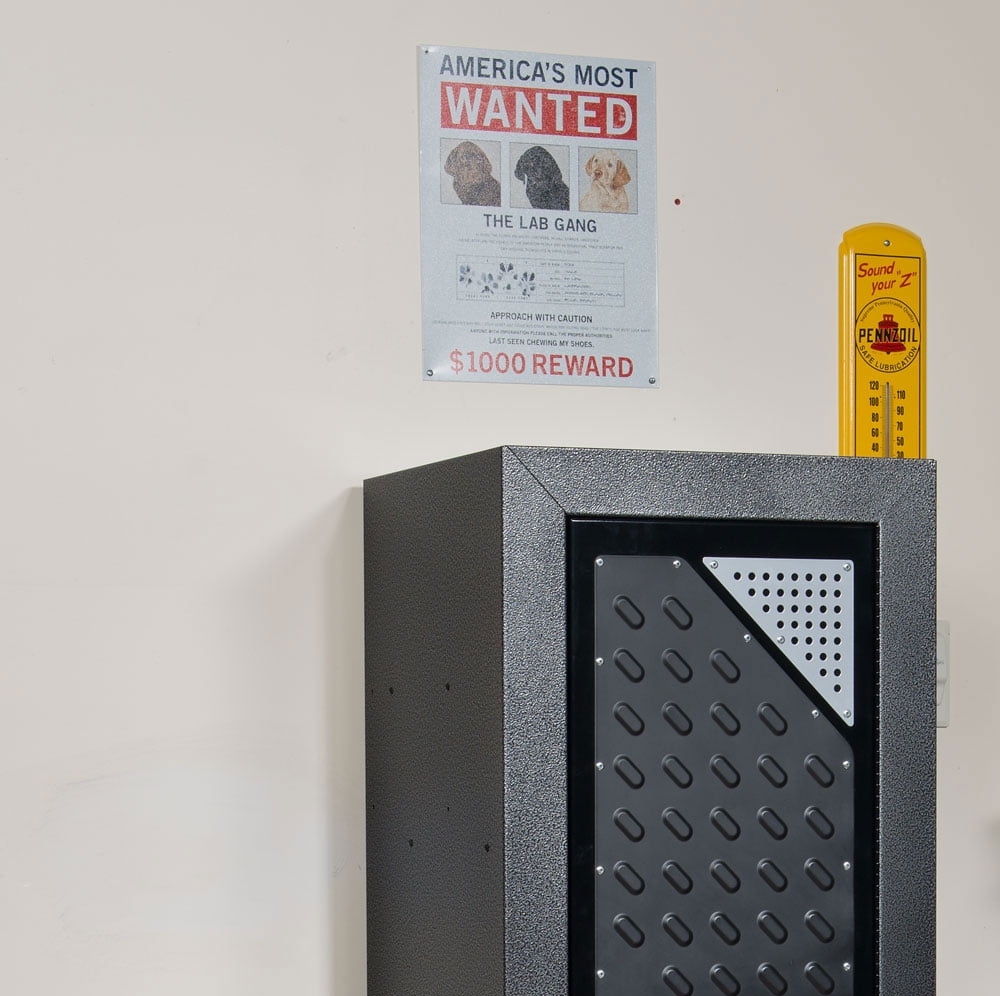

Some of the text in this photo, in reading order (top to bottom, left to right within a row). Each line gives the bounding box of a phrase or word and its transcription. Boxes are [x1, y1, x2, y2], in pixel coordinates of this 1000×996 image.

[440, 54, 638, 89] AMERICA'S MOST
[446, 85, 634, 136] WANTED
[483, 213, 598, 233] THE LAB GANG
[857, 261, 896, 278] Sound
[871, 279, 896, 295] your
[490, 311, 593, 323] APPROACH WITH CAUTION
[858, 327, 918, 343] PENNZOIL
[489, 337, 506, 345] LAST
[527, 338, 558, 347] CHEWING
[570, 340, 595, 348] SHOES.
[450, 348, 634, 378] $1000 REWARD
[860, 344, 917, 371] SAFE LUBRICATION
[869, 381, 880, 390] 120
[896, 390, 906, 400] 110
[869, 397, 880, 407] 100
[896, 406, 905, 416] 90
[871, 413, 880, 422] 80
[896, 422, 904, 431] 70
[871, 428, 880, 438] 60
[896, 437, 905, 446] 50
[871, 443, 880, 453] 40
